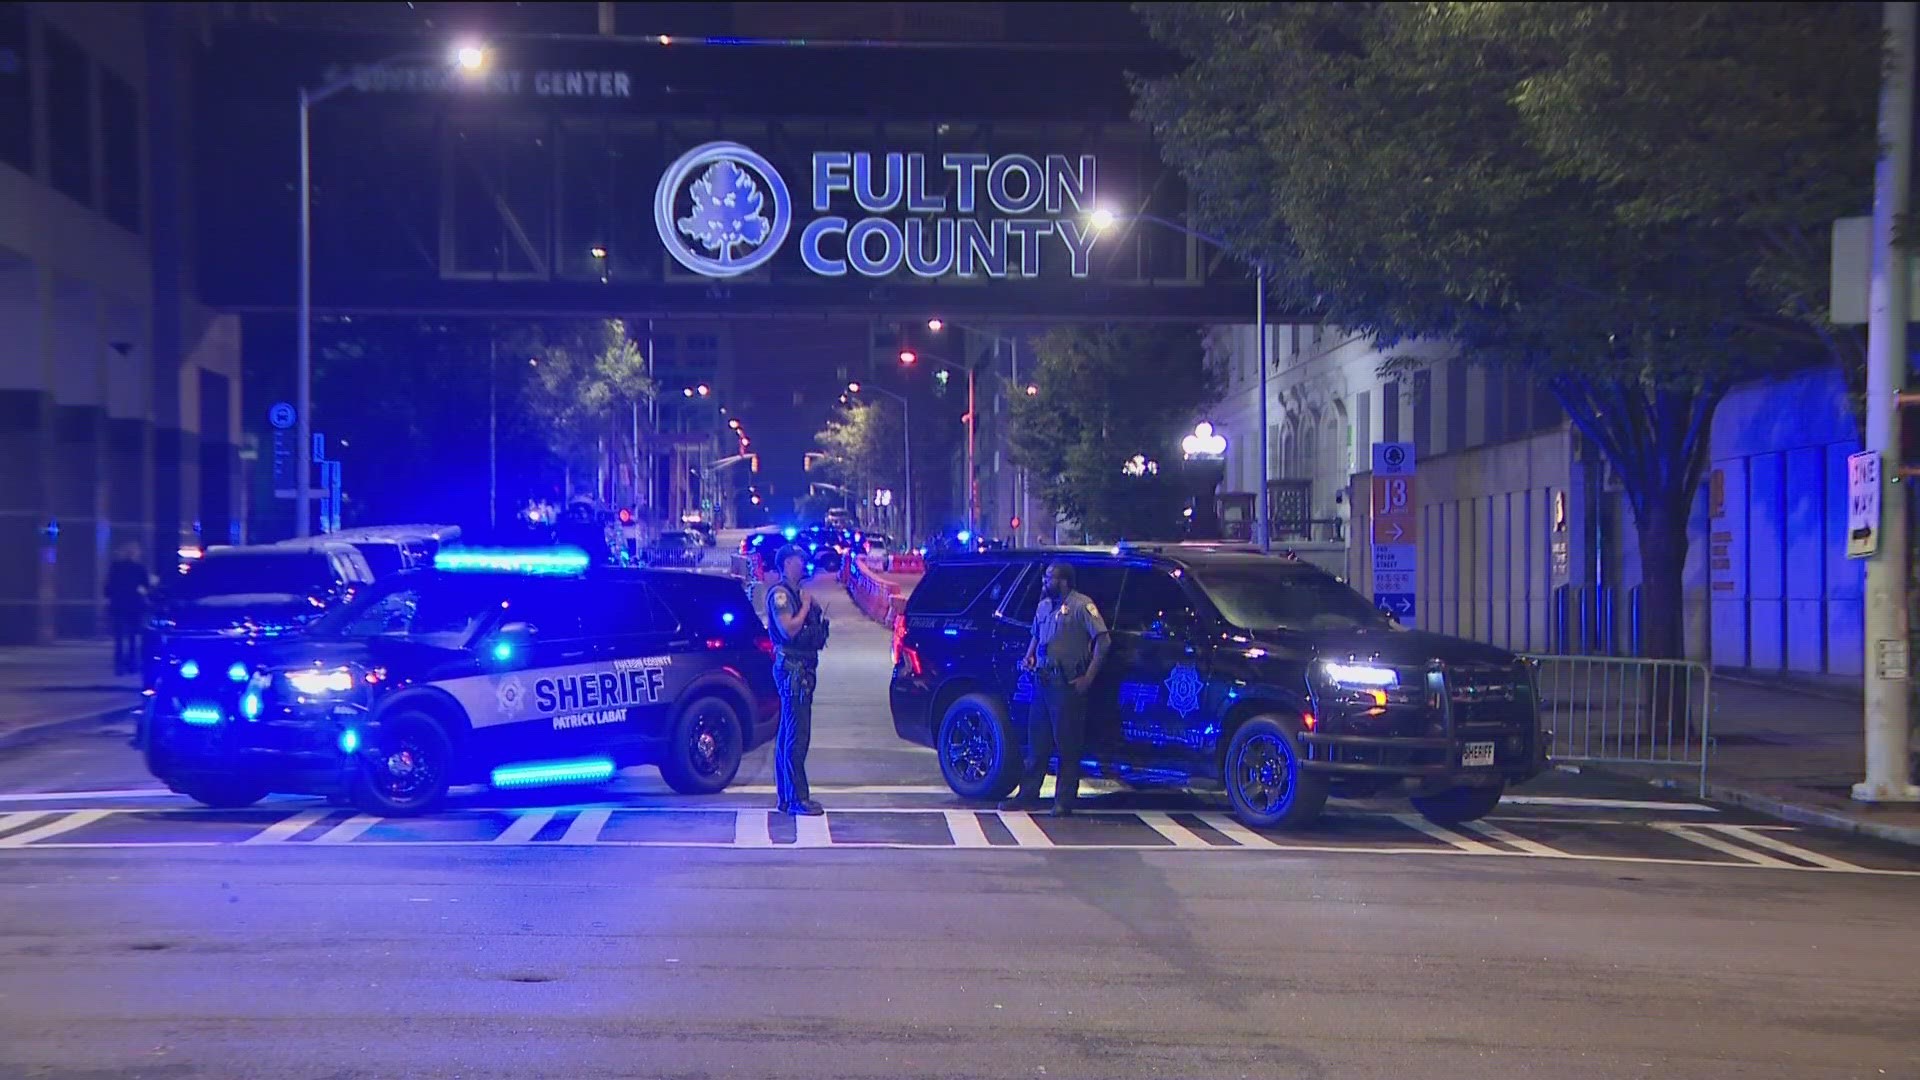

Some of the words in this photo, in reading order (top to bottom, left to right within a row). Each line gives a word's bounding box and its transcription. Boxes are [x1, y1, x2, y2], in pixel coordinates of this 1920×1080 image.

[535, 72, 631, 97] CENTER
[812, 153, 1096, 213] FULTON
[800, 217, 1102, 277] COUNTY
[1853, 459, 1876, 485] ONE
[1379, 479, 1406, 514] J3
[1853, 493, 1874, 516] WAY
[535, 667, 664, 714] SHERIFF
[552, 714, 595, 730] PATRICK
[596, 709, 627, 725] LABAT
[1463, 745, 1492, 759] SHERIFF
